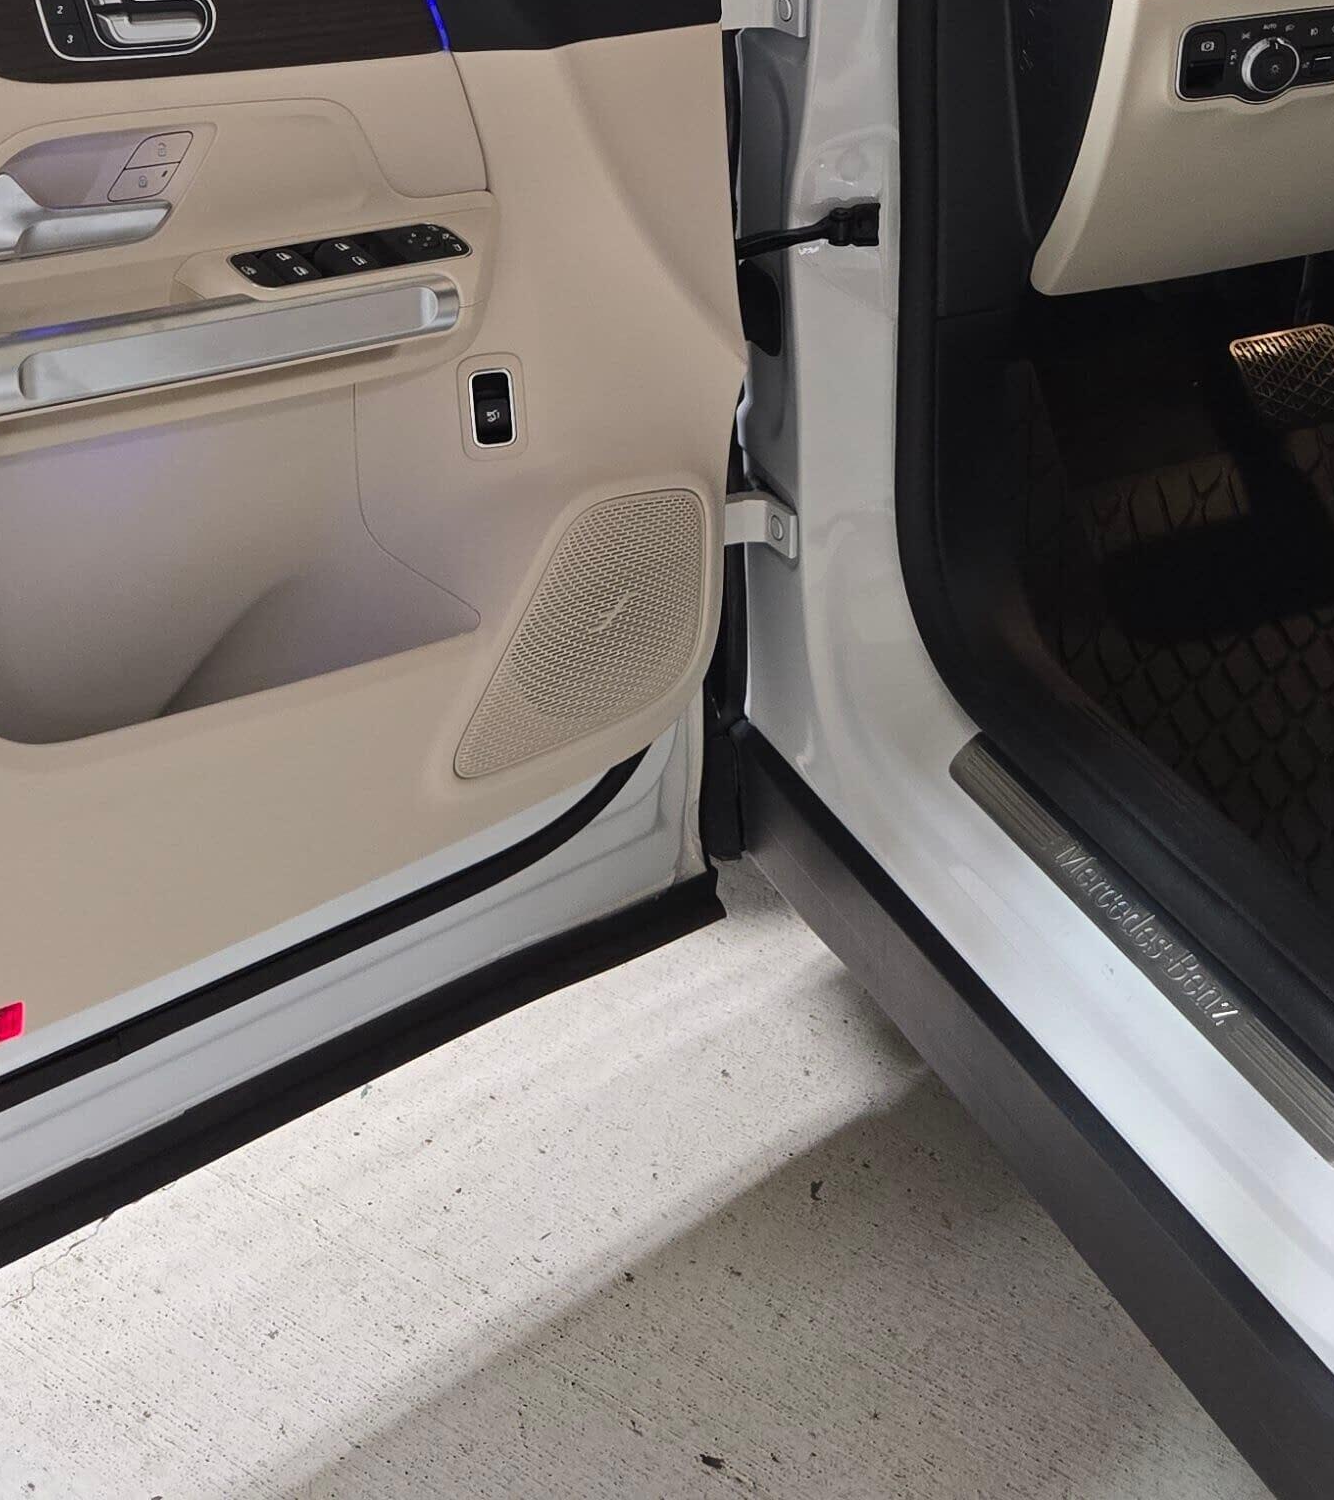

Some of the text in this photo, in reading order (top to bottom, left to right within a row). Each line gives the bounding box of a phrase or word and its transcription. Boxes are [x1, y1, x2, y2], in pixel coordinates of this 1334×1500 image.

[57, 5, 64, 15] 2
[67, 34, 74, 44] 3
[1054, 844, 1239, 1027] Mercedes-Benz
